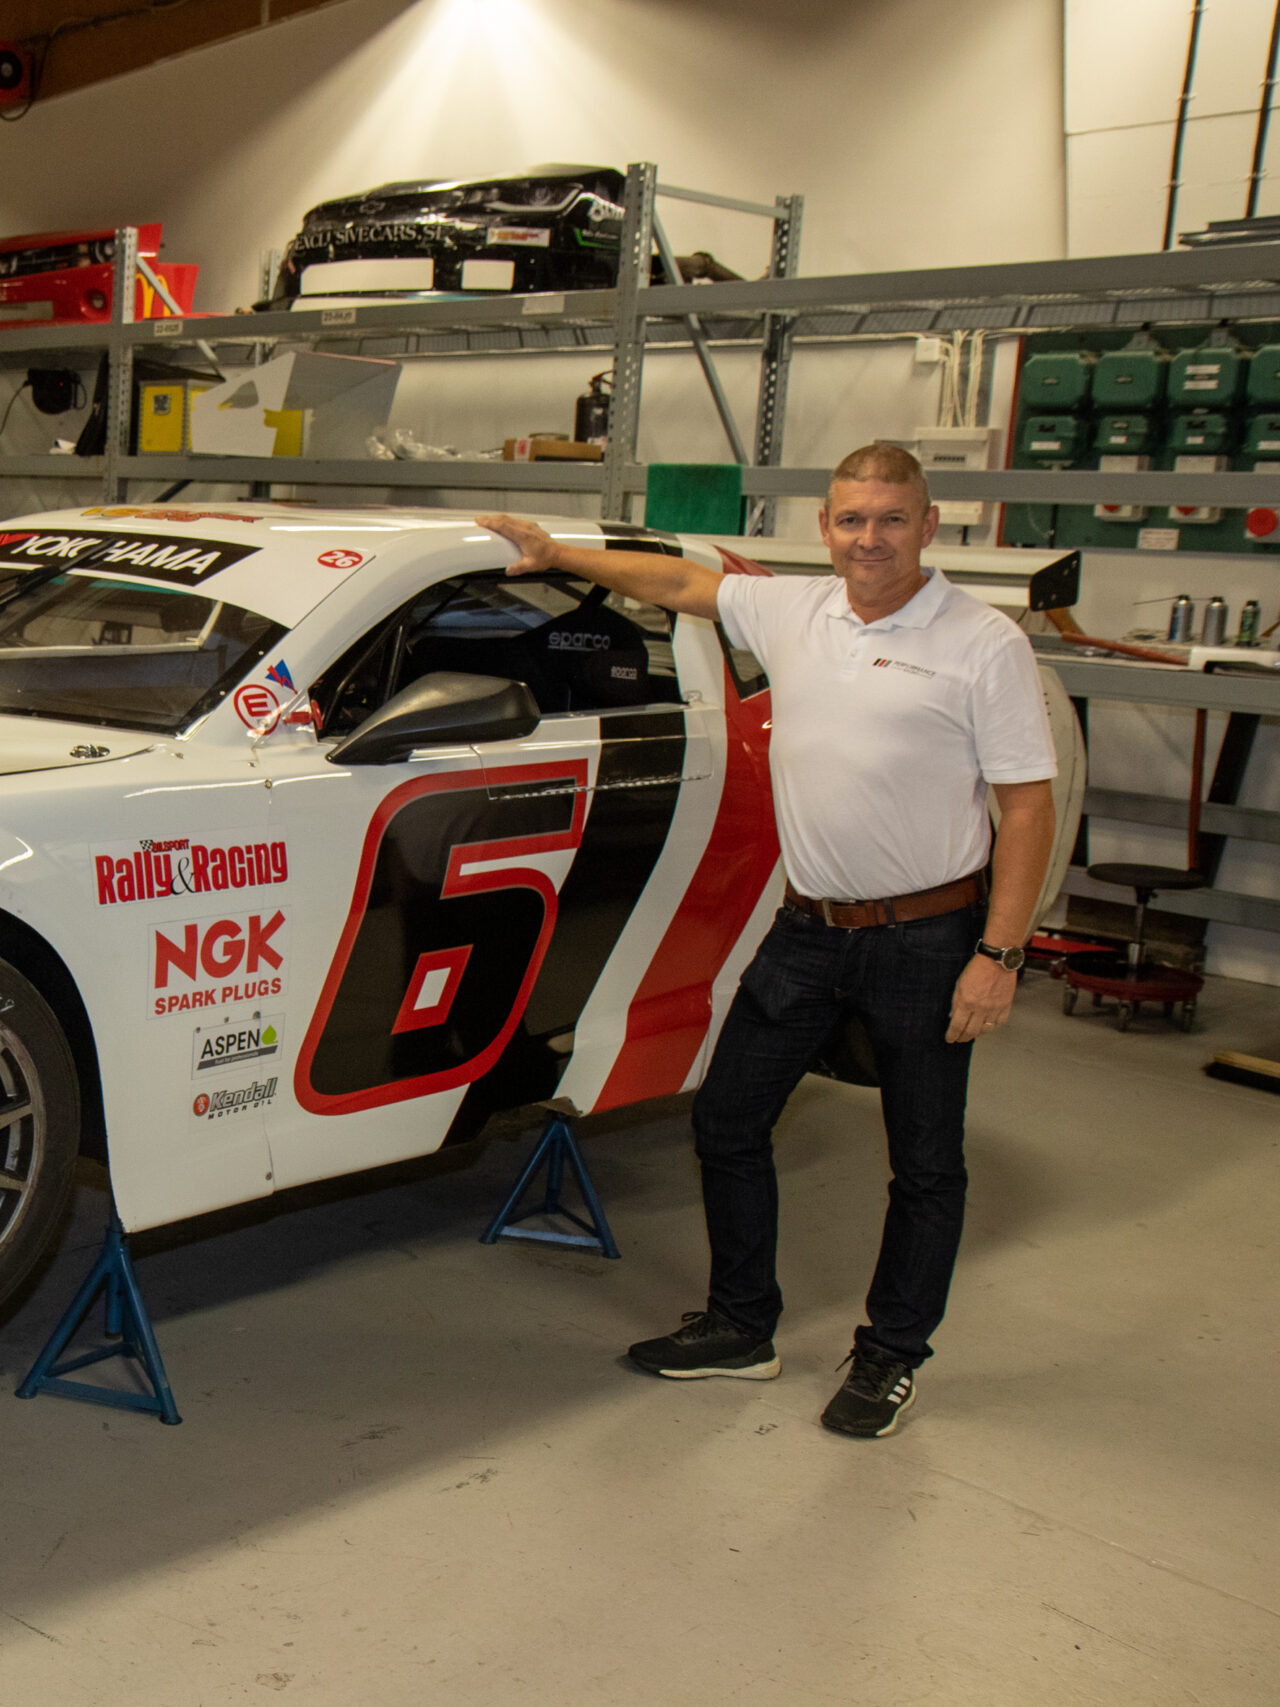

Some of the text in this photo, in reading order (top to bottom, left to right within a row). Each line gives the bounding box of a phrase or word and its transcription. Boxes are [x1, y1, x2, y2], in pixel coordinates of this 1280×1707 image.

[320, 550, 362, 568] 26
[548, 631, 611, 650] sparco
[95, 850, 173, 905] Rally
[191, 841, 288, 893] Racing
[154, 909, 286, 989] NGK
[294, 758, 588, 1116] 6
[154, 977, 282, 1015] SPARK PLUGS
[200, 1028, 260, 1060] ASPEN
[208, 1099, 272, 1120] MOTOR OIL
[209, 1077, 278, 1112] Kendall
